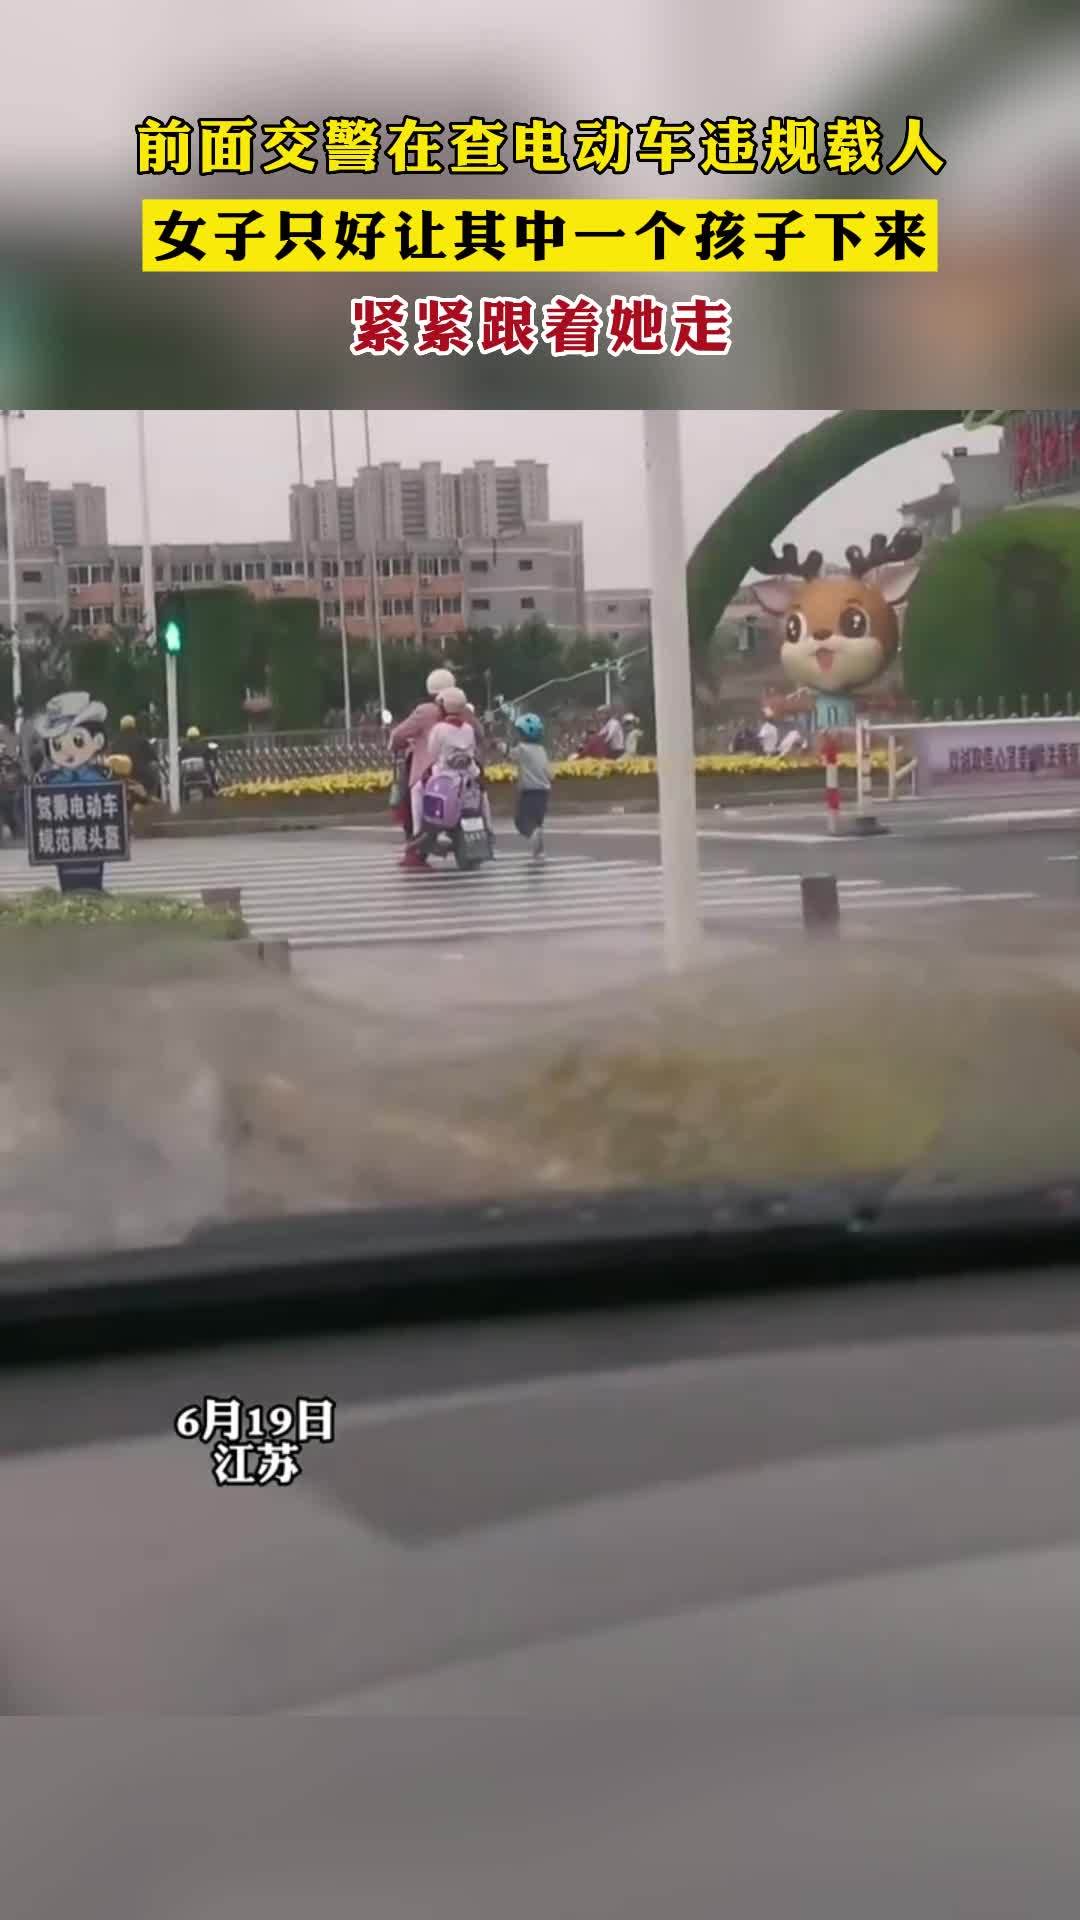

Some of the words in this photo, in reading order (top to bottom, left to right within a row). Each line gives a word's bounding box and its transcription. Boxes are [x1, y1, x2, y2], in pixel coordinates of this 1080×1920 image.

[36, 793, 118, 821] 驾乘电动车
[38, 825, 120, 854] 规范戴头盔
